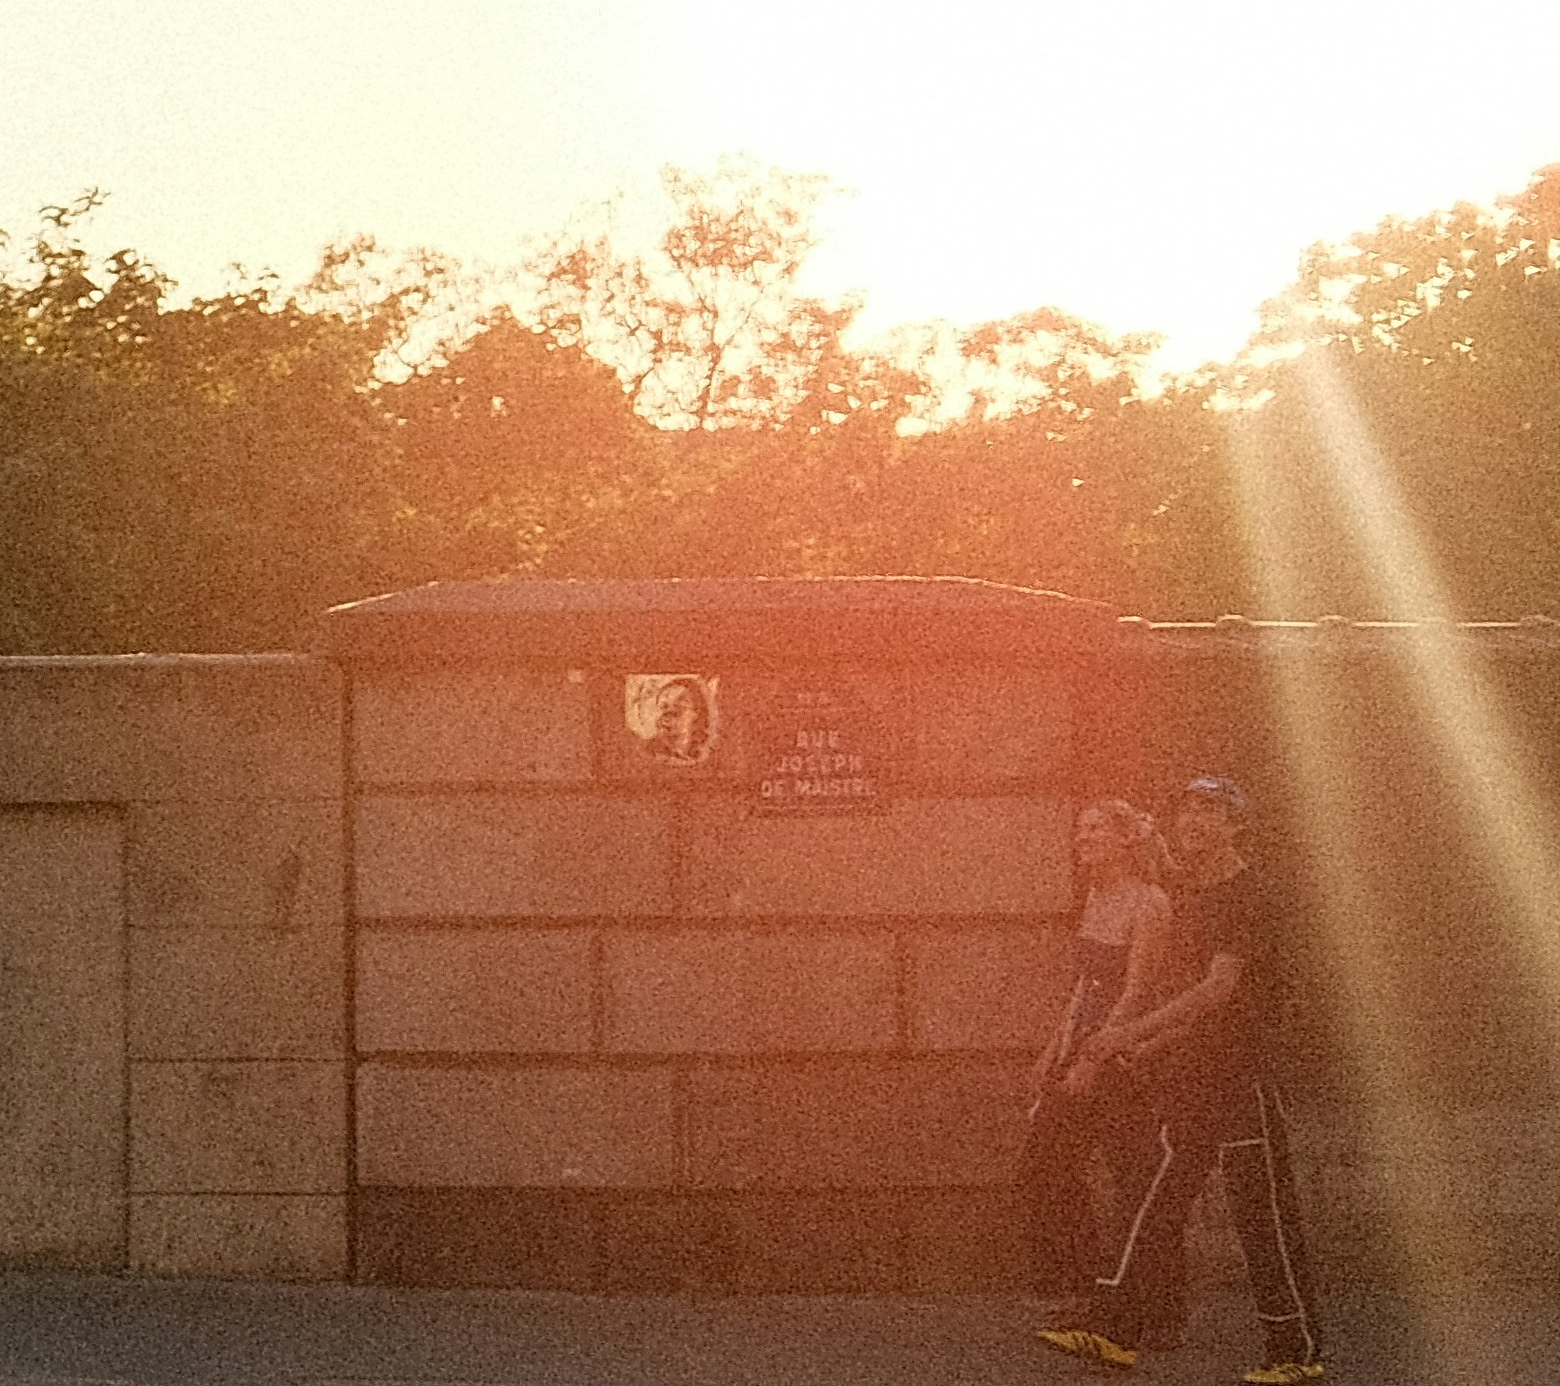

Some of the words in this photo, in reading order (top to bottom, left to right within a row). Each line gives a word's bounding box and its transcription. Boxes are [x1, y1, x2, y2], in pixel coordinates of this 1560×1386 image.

[797, 730, 840, 748] RUE
[776, 754, 864, 774] JOSEPH
[761, 779, 786, 798] DE
